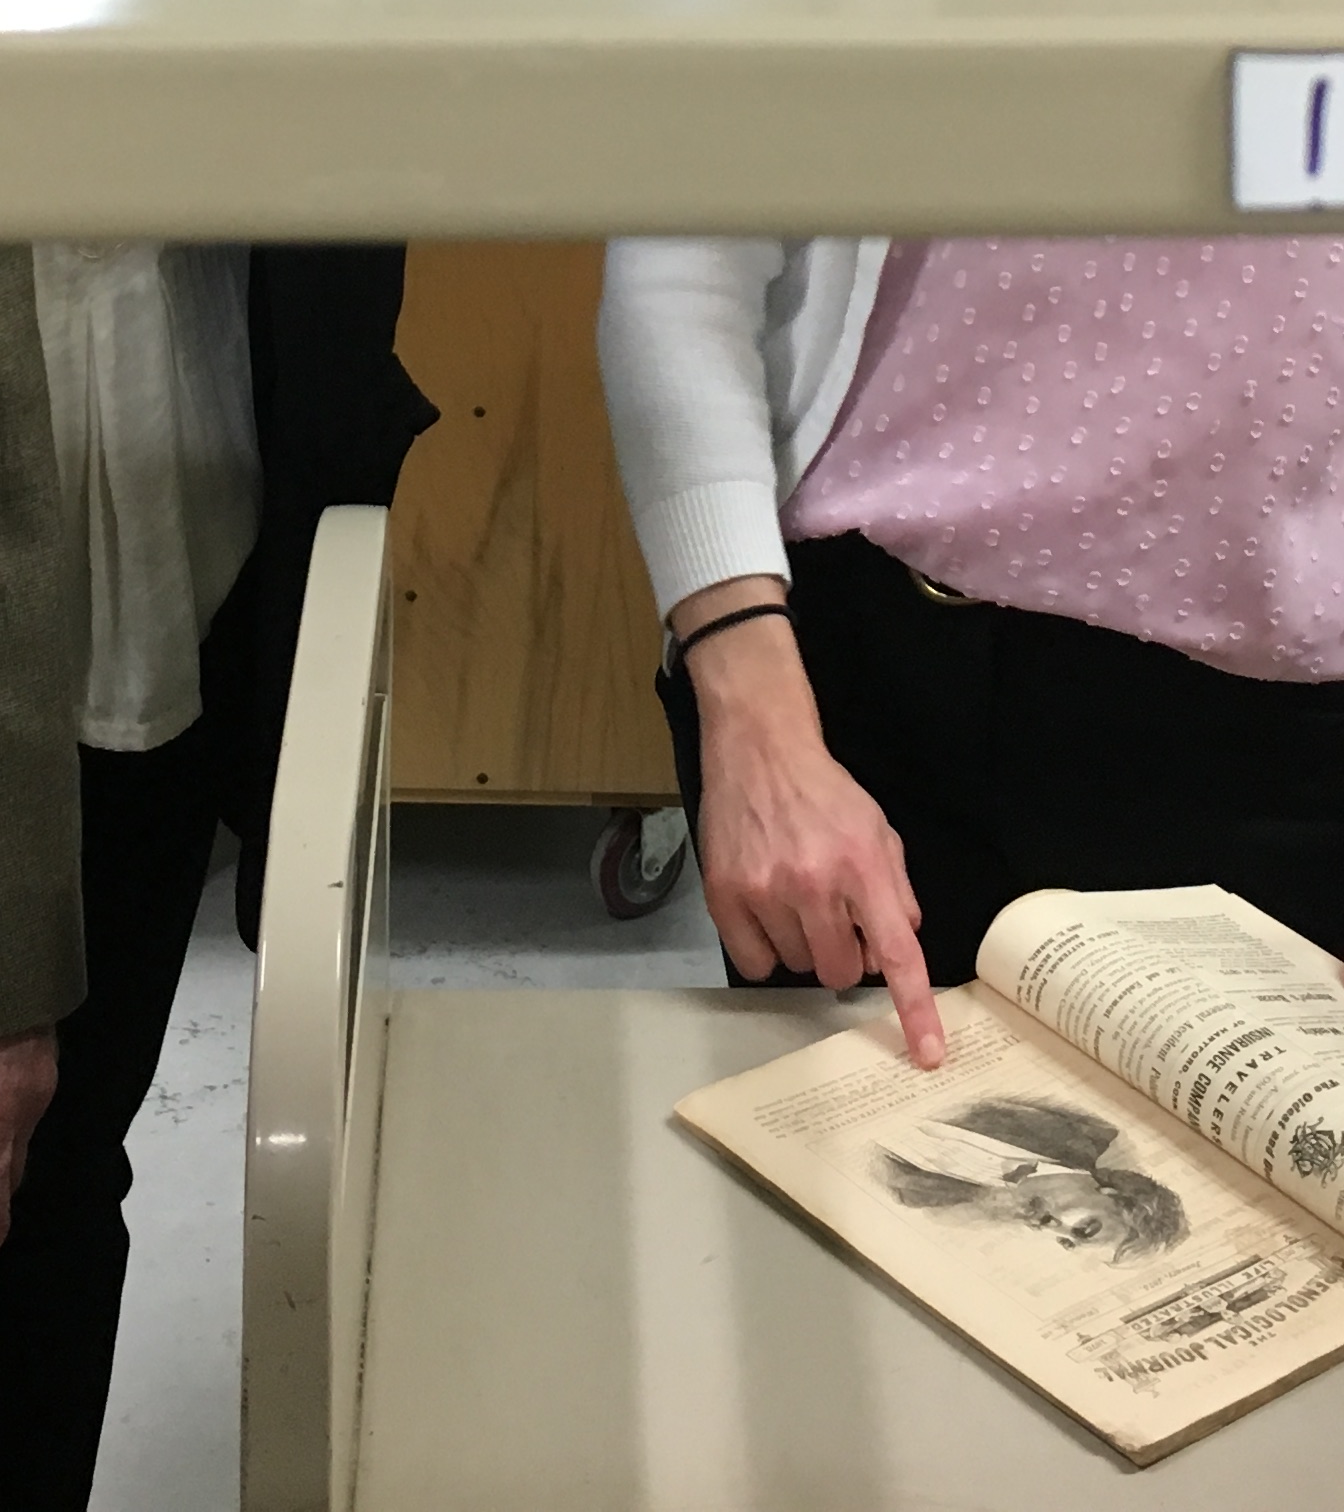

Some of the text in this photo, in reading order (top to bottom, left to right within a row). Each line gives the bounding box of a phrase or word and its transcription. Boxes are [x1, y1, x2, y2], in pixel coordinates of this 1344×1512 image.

[1100, 979, 1144, 1019] Endowment
[1194, 1000, 1237, 1023] General
[1154, 1020, 1195, 1062] Accident
[1185, 1025, 1275, 1132] INSURANCE COMPAN
[1210, 1044, 1287, 1147] TRAVELERS
[1312, 1077, 1340, 1093] The
[1275, 1090, 1315, 1130] Oldest
[1262, 1129, 1282, 1159] and
[1239, 1259, 1276, 1280] LIFE
[1246, 1330, 1277, 1347] THE
[1092, 1342, 1209, 1381] JOURNAL
